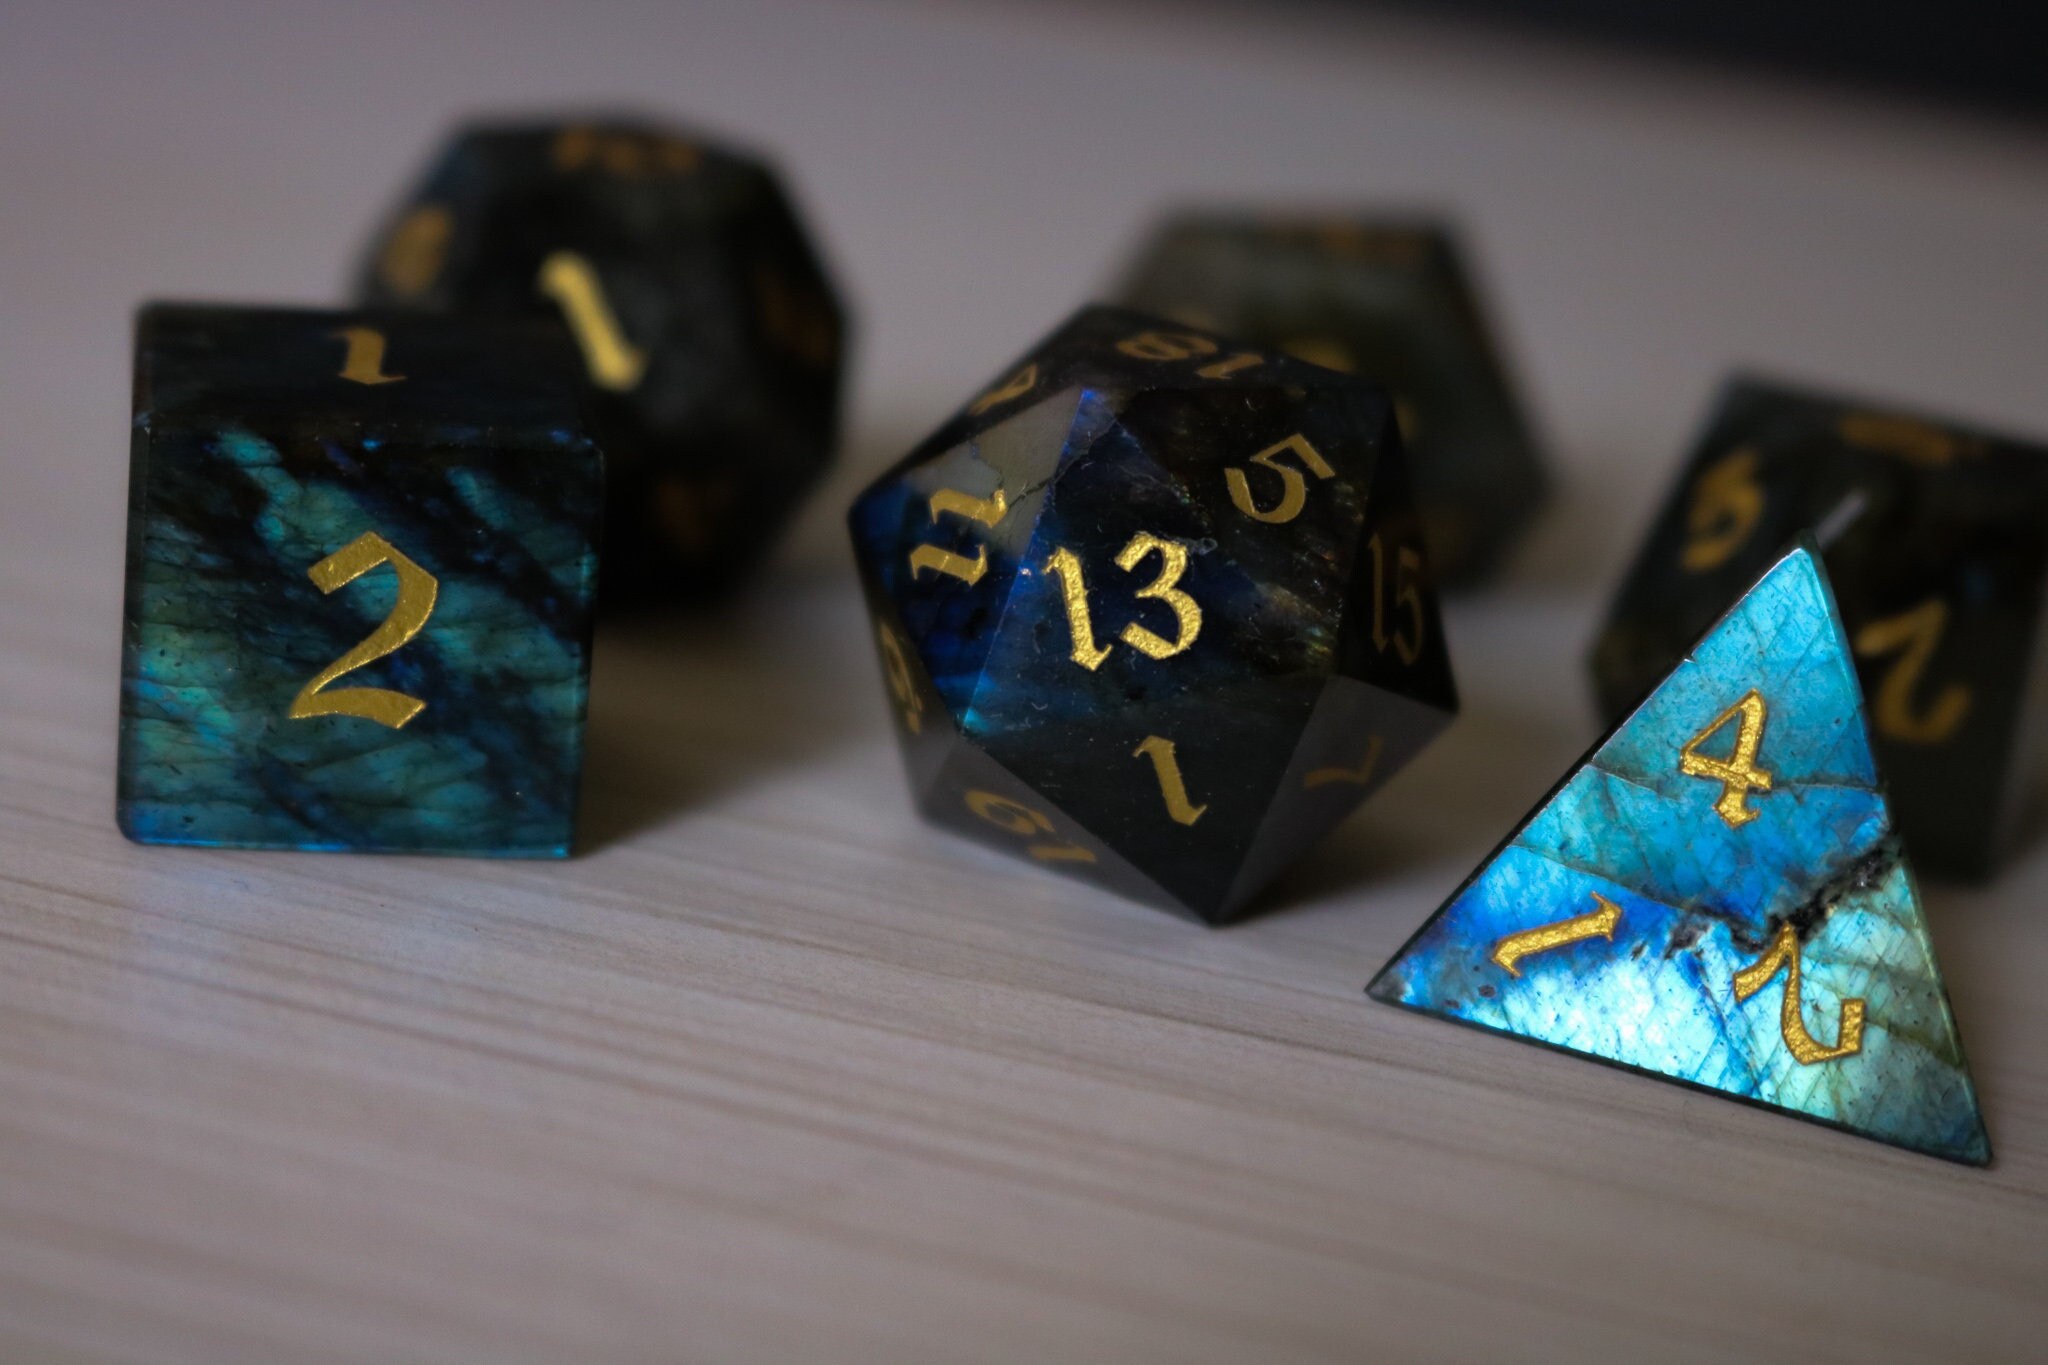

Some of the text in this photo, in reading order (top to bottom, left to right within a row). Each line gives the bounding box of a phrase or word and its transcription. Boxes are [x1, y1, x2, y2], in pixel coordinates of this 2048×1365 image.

[335, 327, 404, 386] 1
[909, 487, 1009, 586] 11
[1224, 432, 1336, 524] 5
[289, 531, 438, 729] 2
[1044, 531, 1203, 671] 13
[1367, 532, 1424, 666] 15
[1856, 601, 1970, 743] 2
[1133, 735, 1206, 826] 1
[1681, 687, 1773, 828] 4
[1492, 892, 1622, 977] 1
[1733, 920, 1867, 1066] 2
